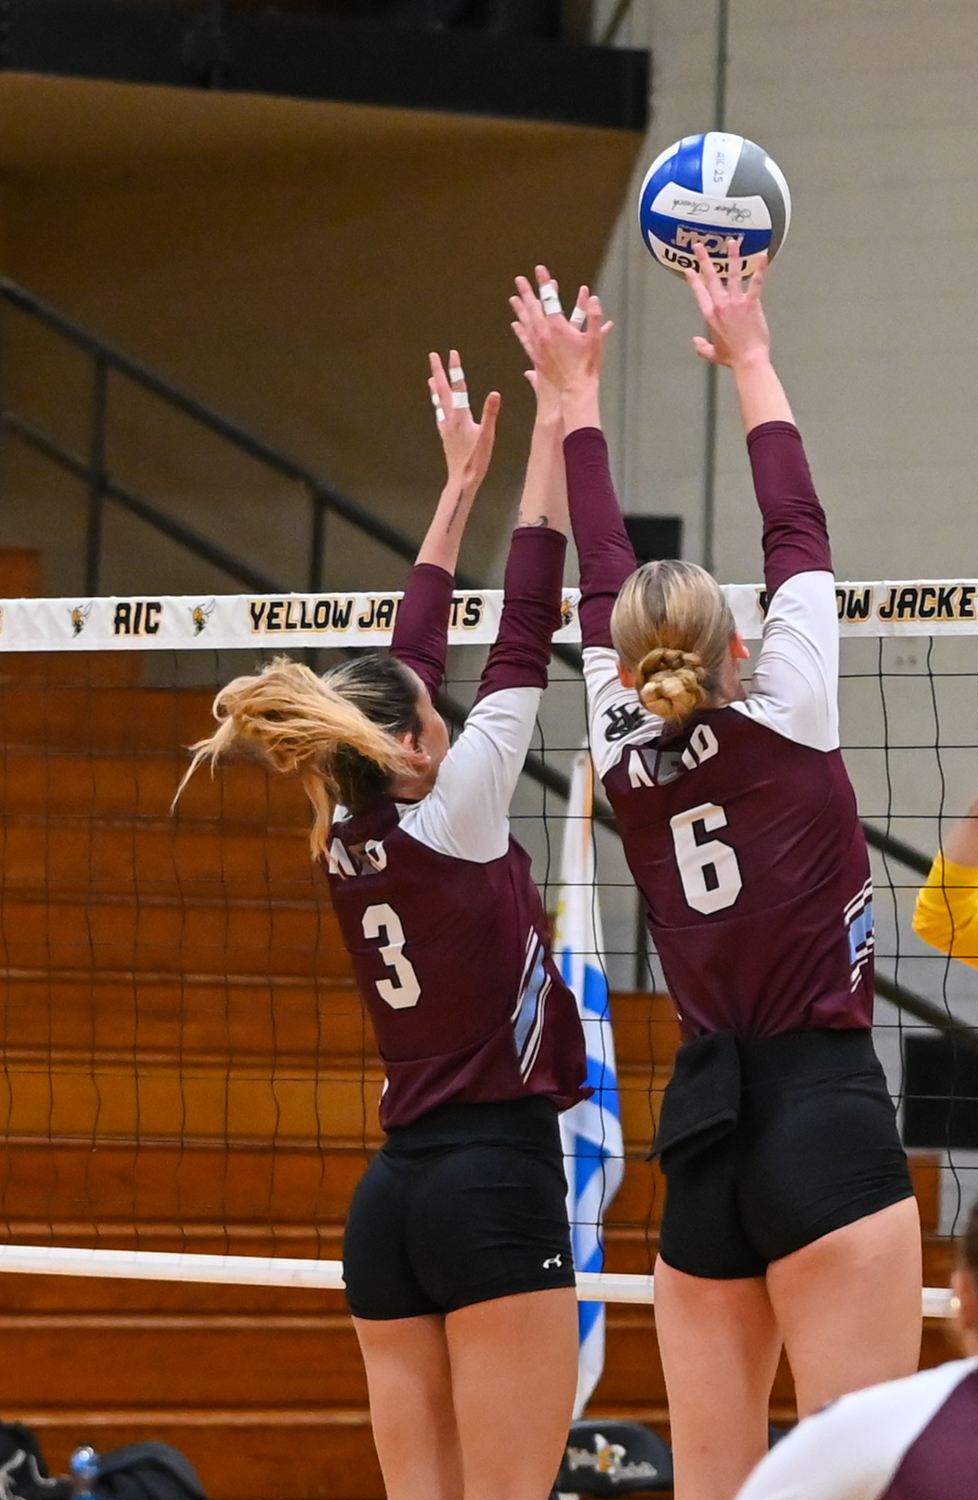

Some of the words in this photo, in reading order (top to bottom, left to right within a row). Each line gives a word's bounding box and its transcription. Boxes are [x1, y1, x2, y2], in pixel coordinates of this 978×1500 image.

[113, 601, 163, 636] AIC
[250, 597, 357, 633] YELLOW
[358, 593, 485, 628] JATS
[670, 802, 744, 916] 6
[361, 902, 422, 1011] 3
